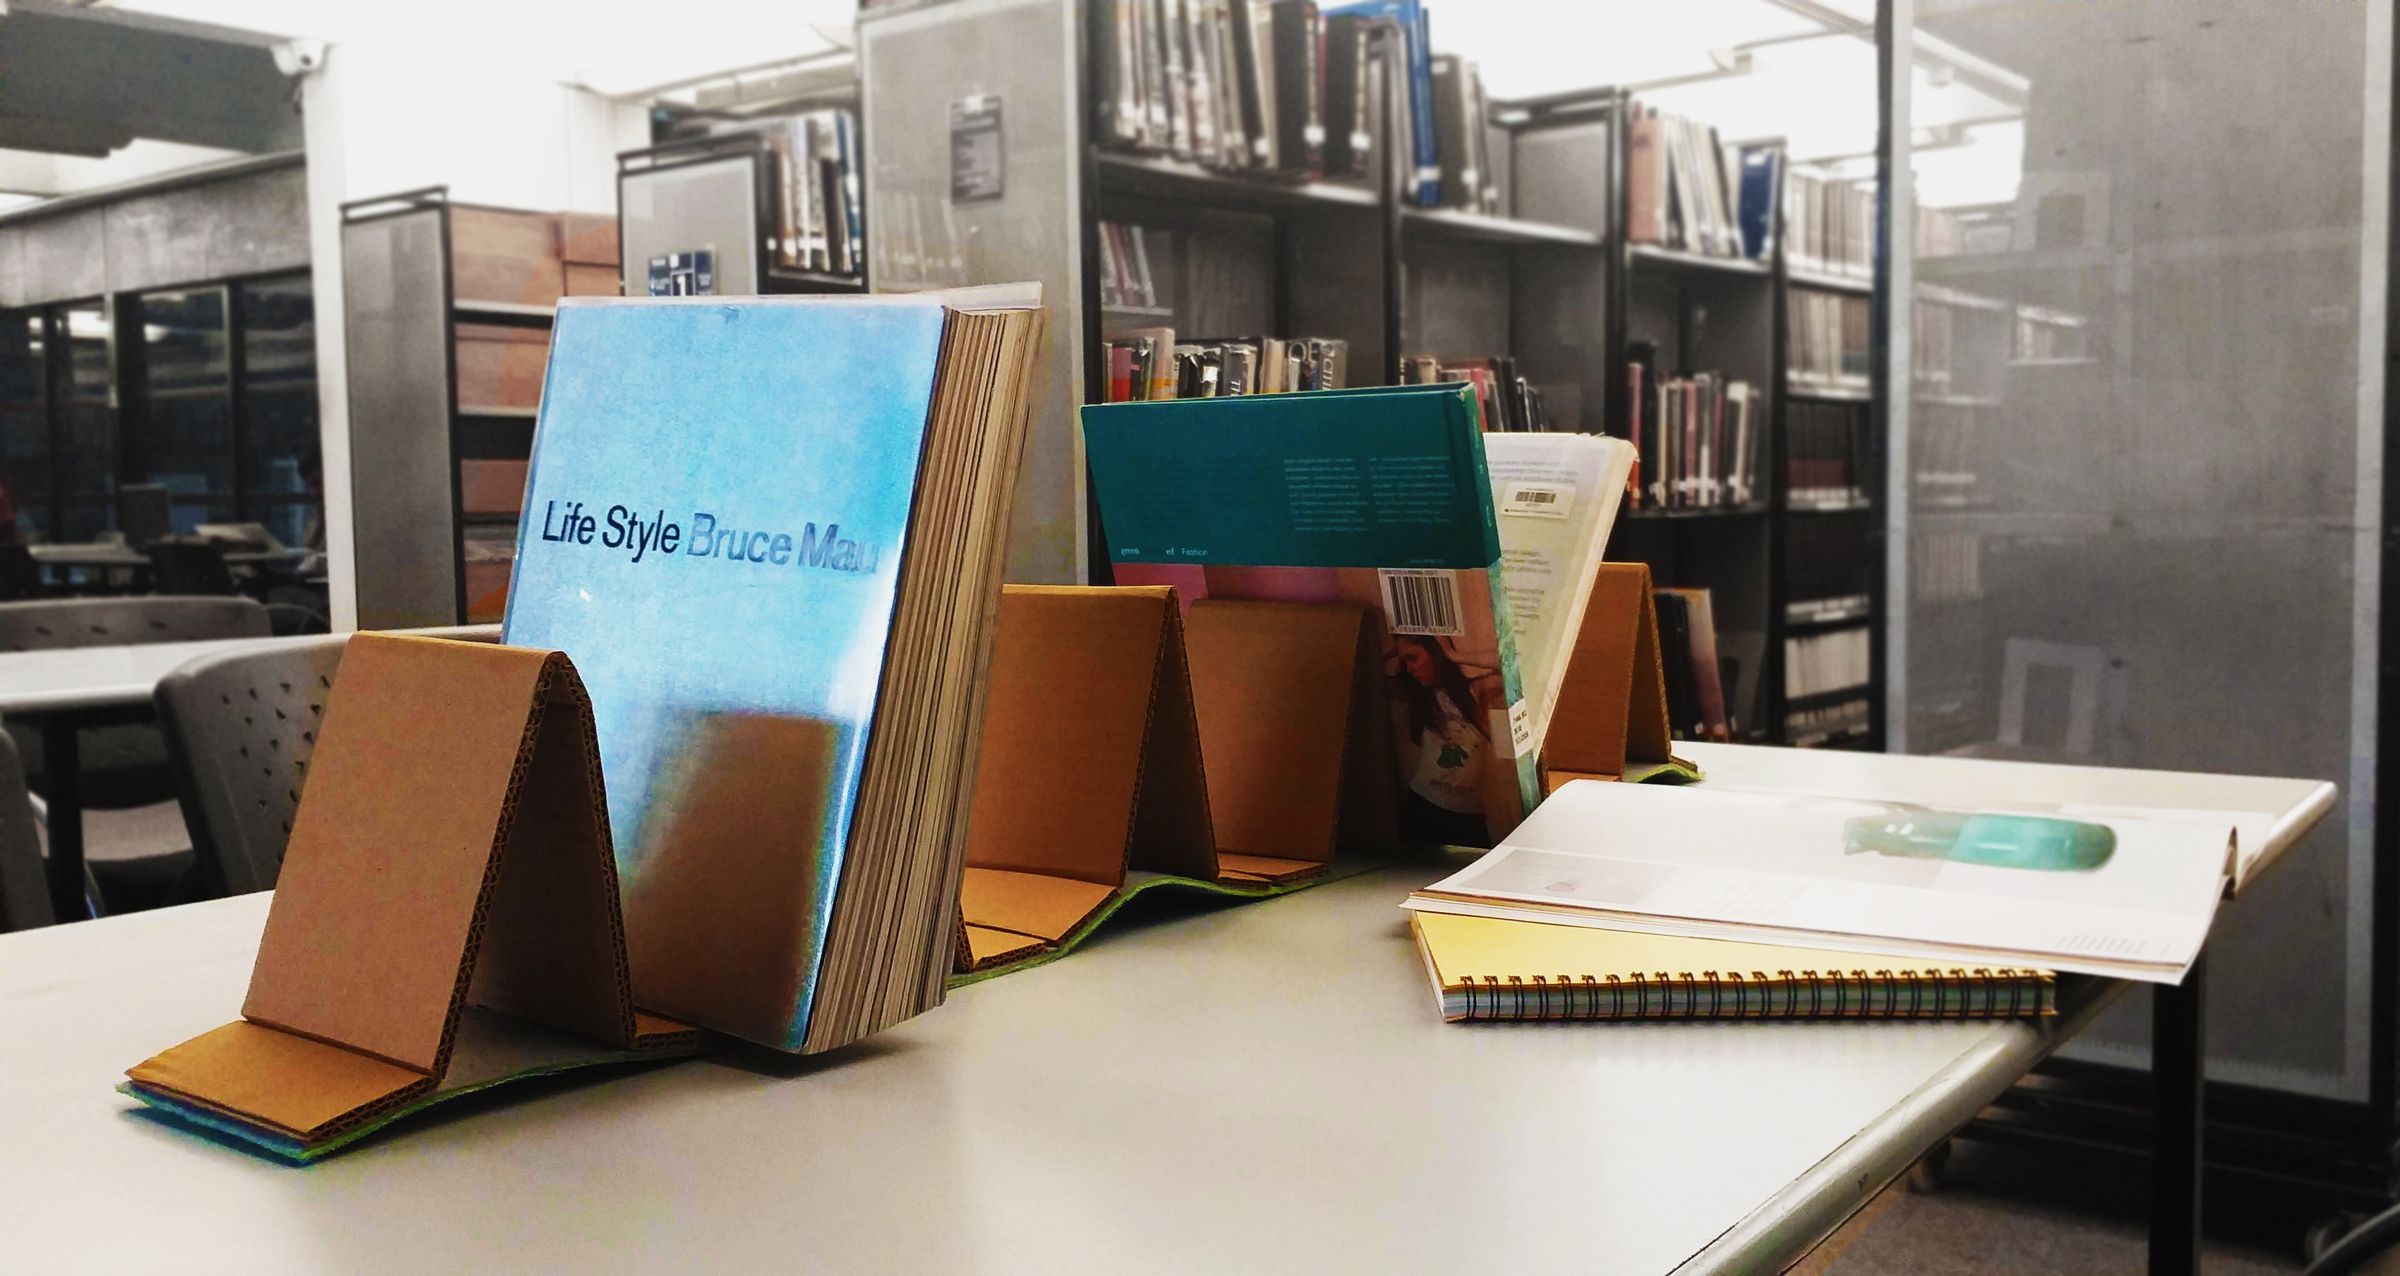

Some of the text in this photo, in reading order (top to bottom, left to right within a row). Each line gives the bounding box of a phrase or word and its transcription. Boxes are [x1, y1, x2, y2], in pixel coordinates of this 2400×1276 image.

[541, 500, 880, 574] Life Style Bruce Mau
